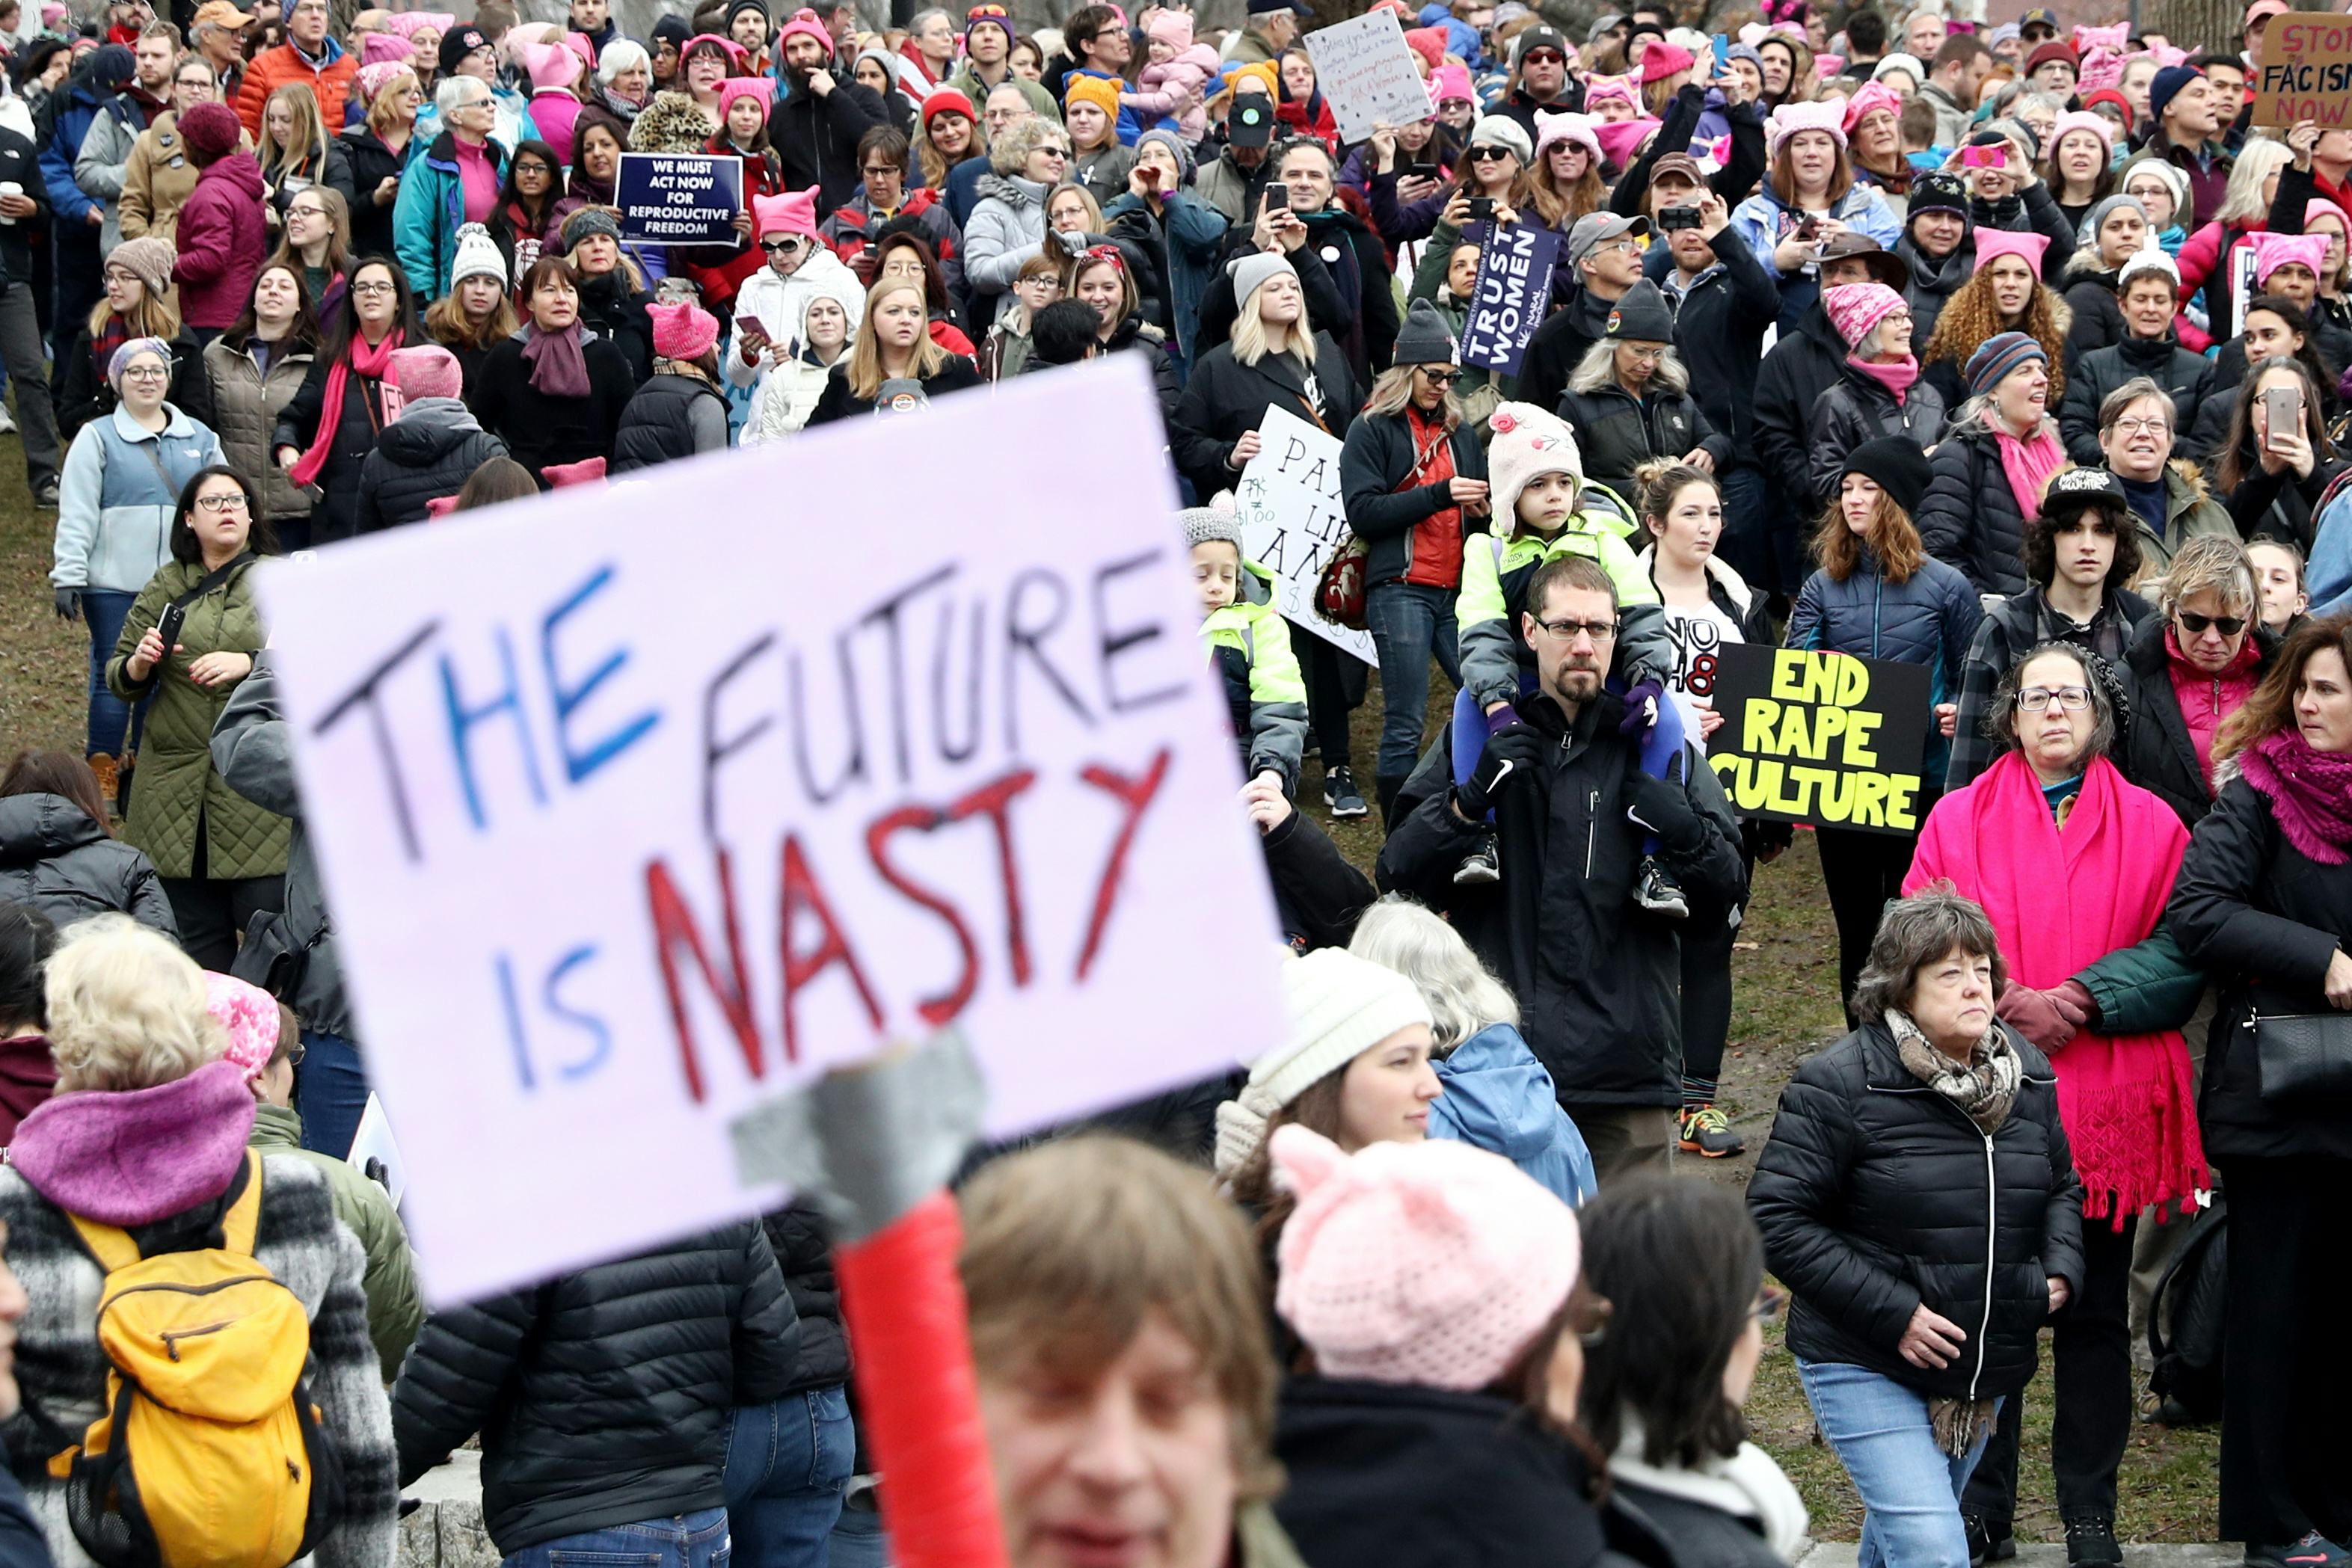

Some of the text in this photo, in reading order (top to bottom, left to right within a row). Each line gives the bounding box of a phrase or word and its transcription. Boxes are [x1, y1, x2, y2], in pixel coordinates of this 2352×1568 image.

[2276, 97, 2351, 124] NOW
[649, 176, 713, 189] ACT NOW
[652, 160, 713, 174] WE MUST
[629, 206, 729, 220] REPRODUCTIVE
[666, 192, 694, 204] FOR
[645, 221, 707, 234] FREEDOM
[1468, 224, 1513, 358] TRUST
[1490, 230, 1535, 364] WOMEN
[1541, 263, 1553, 292] America
[1526, 289, 1541, 325] NARAL
[1304, 505, 1354, 547] LIK
[1258, 527, 1288, 575] A
[1771, 648, 1870, 707] END
[311, 549, 1192, 864] THE FUTURE
[1742, 698, 1882, 768] RAPE
[1708, 753, 1920, 830] CULTURE
[493, 746, 1173, 1105] IS NASTY
